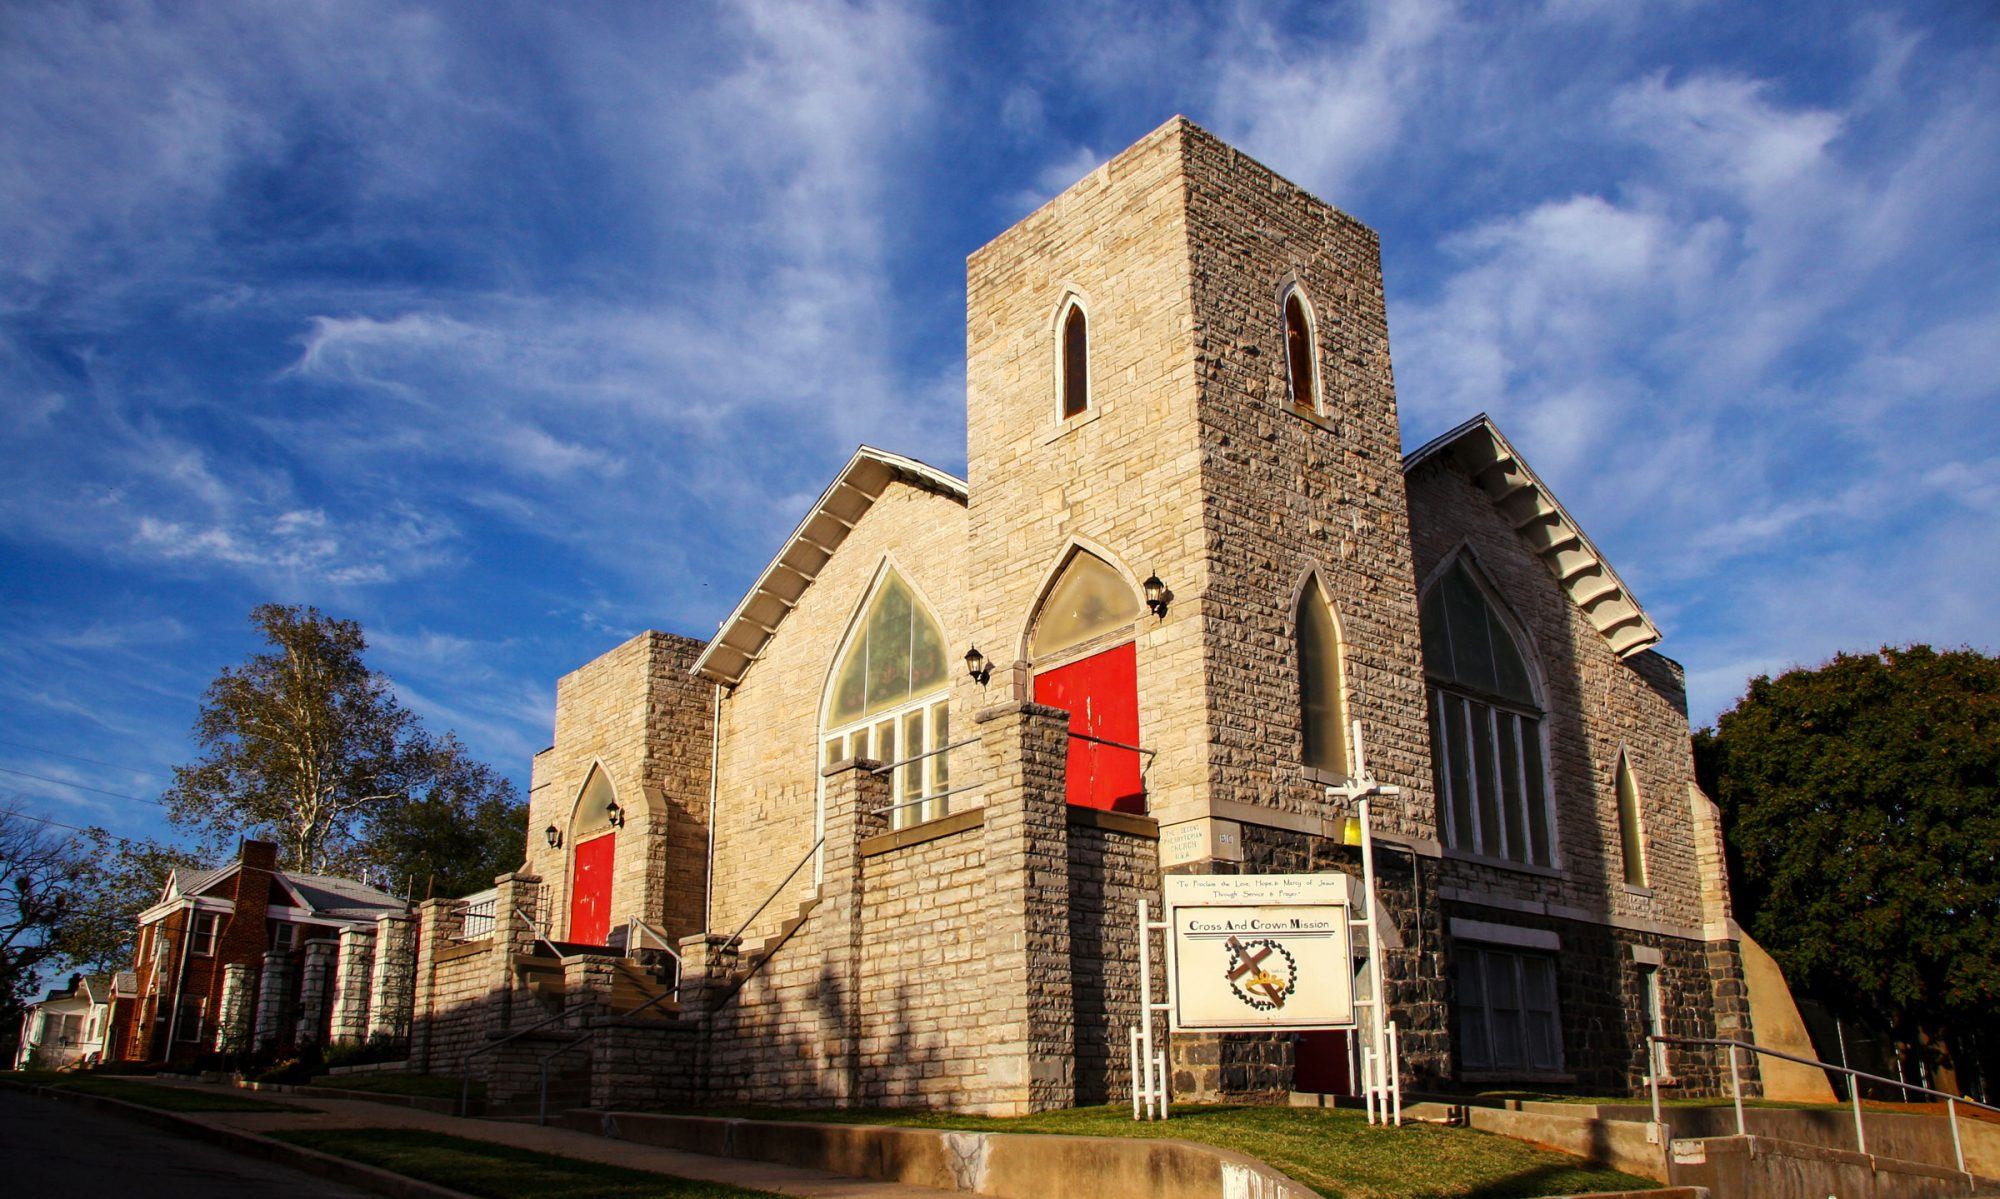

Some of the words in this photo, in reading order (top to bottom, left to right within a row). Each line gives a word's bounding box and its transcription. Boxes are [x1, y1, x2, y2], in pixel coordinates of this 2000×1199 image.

[1283, 879, 1302, 888] Mercy
[1213, 890, 1238, 899] Through
[1243, 890, 1265, 898] Service
[1189, 920, 1222, 931] Cross
[1225, 919, 1248, 931] And
[1250, 919, 1288, 930] Crown
[1290, 918, 1330, 930] Mission
